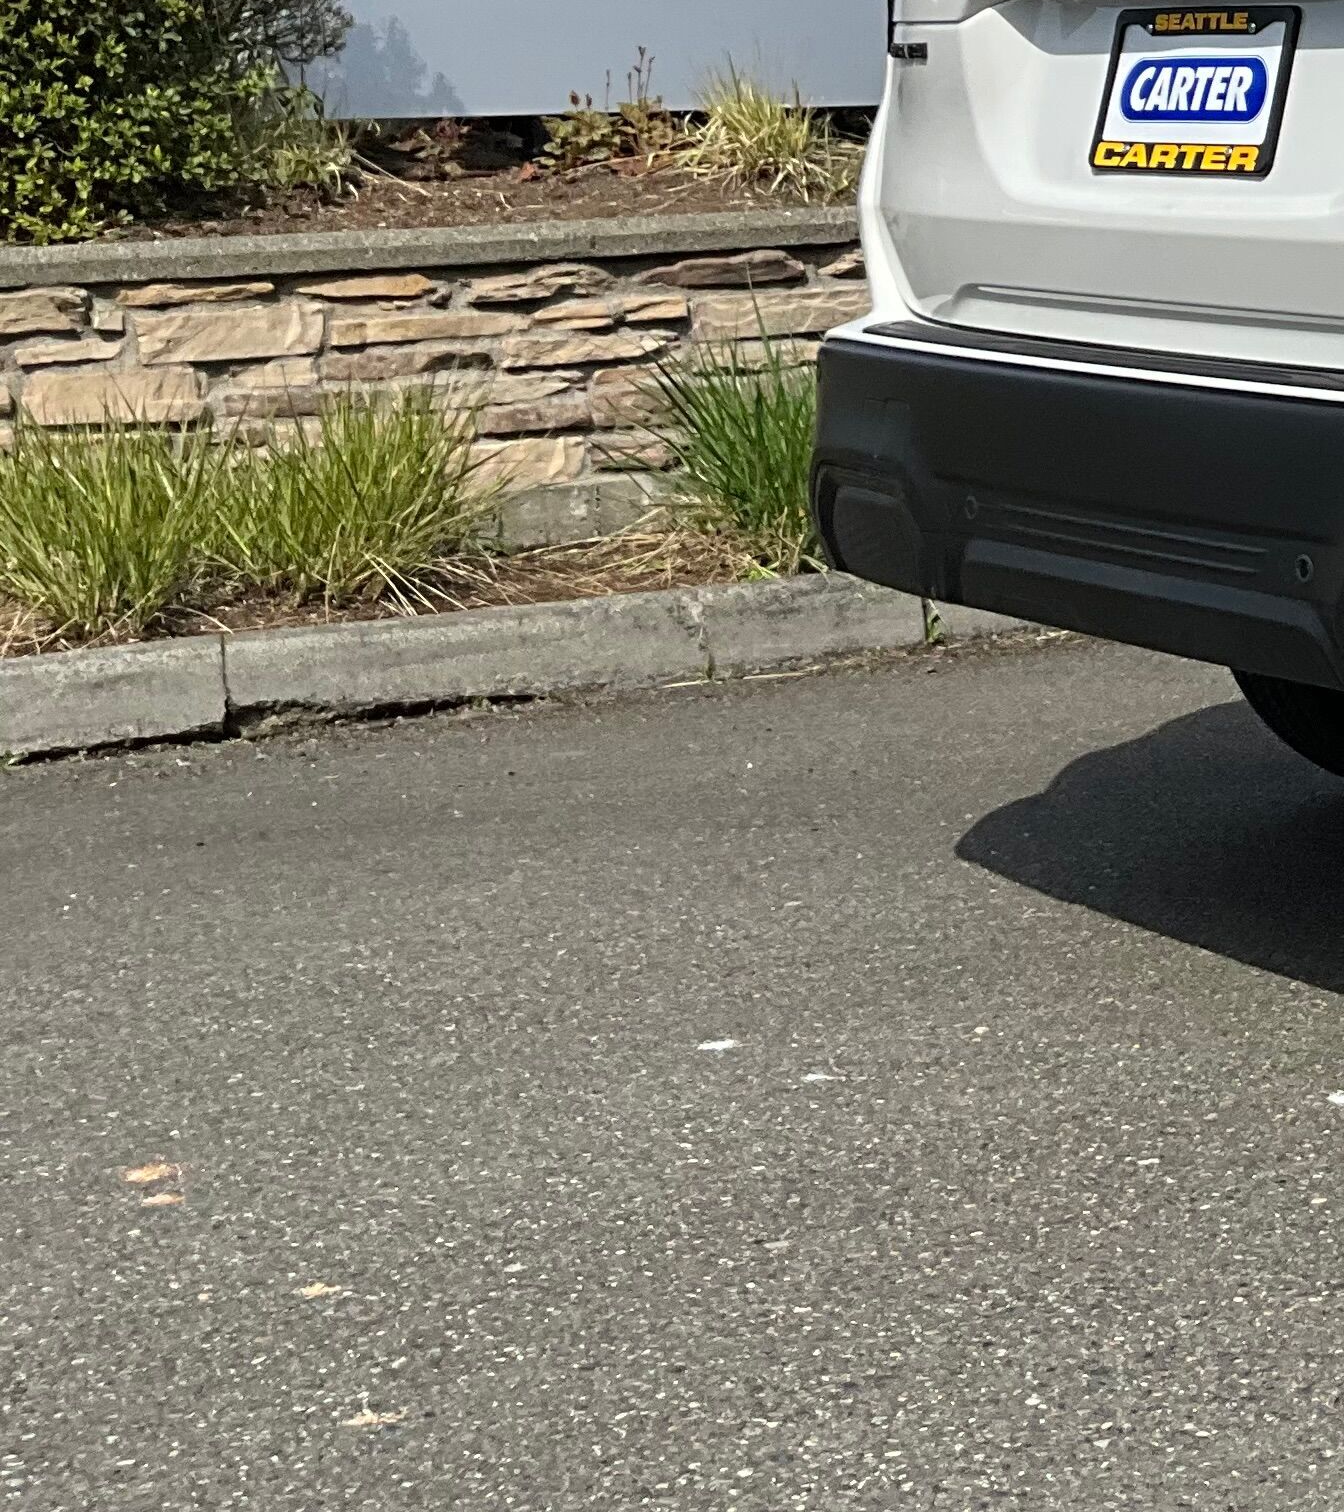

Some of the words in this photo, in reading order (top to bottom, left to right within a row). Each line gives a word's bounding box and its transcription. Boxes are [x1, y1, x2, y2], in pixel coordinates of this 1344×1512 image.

[1155, 12, 1249, 31] SEATTLE
[1129, 65, 1254, 112] CARTER
[1093, 141, 1260, 172] CARTER
